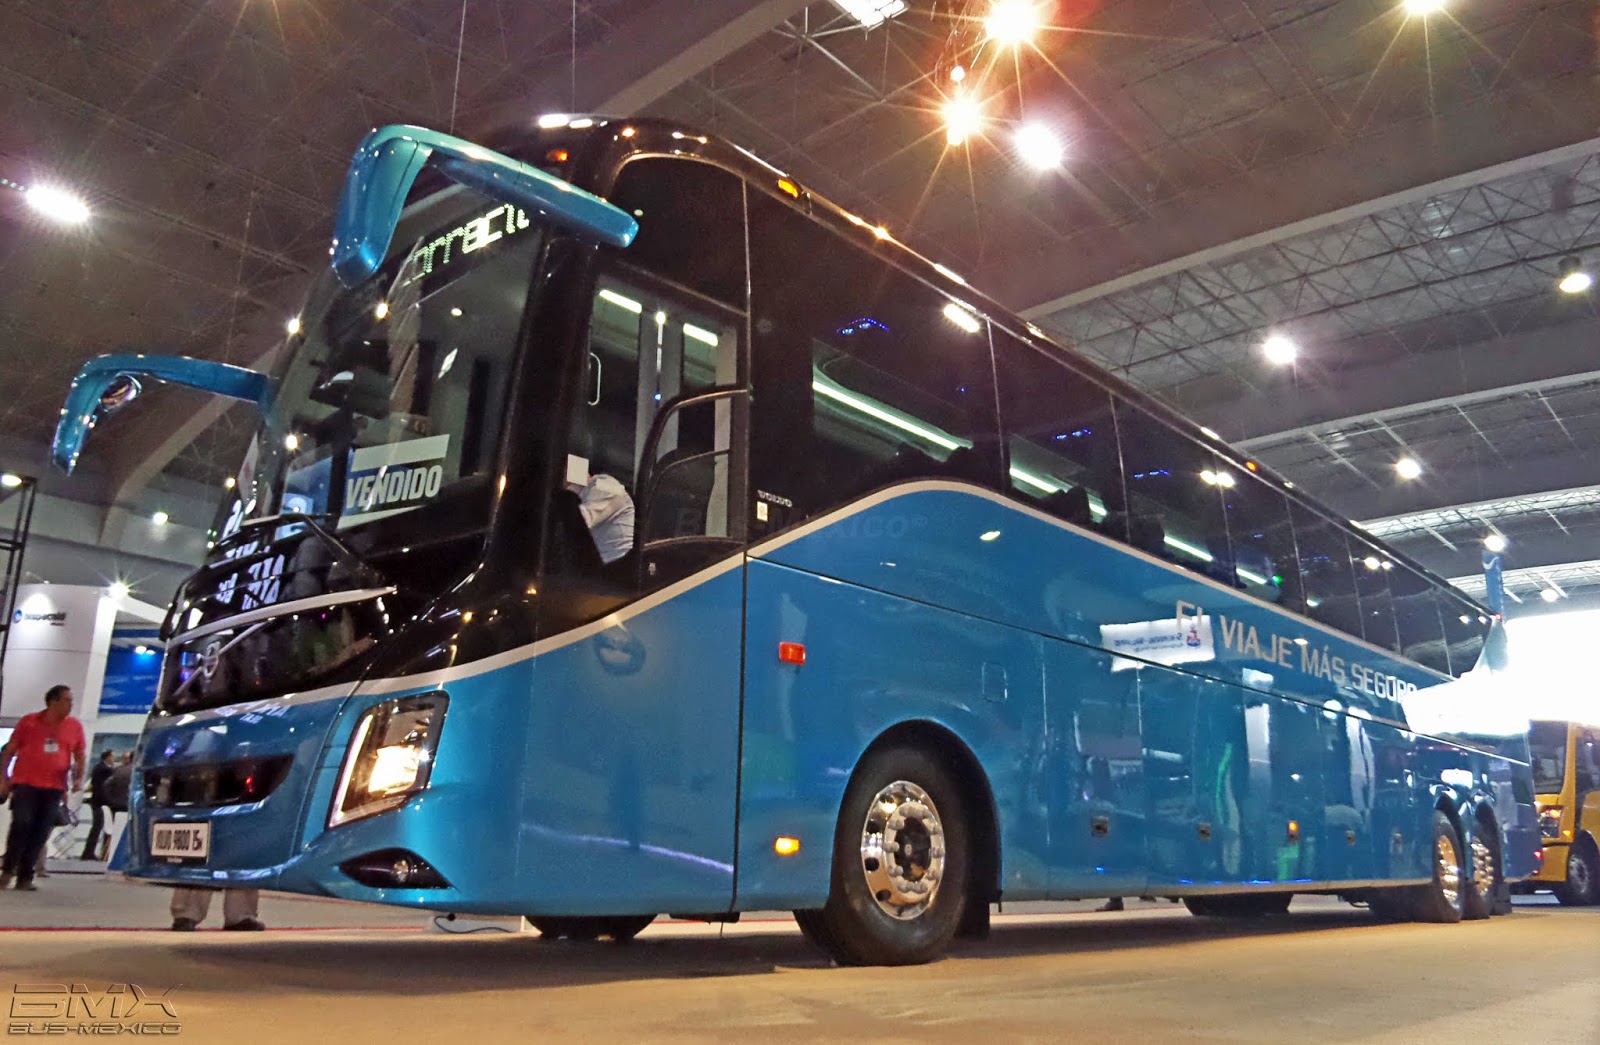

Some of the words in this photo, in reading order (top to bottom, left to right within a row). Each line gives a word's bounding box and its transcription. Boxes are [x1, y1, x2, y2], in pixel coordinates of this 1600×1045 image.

[346, 464, 443, 509] VENDIDO
[1219, 614, 1294, 669] VIAJE
[1301, 641, 1346, 687] MÁS
[173, 829, 191, 850] 9800
